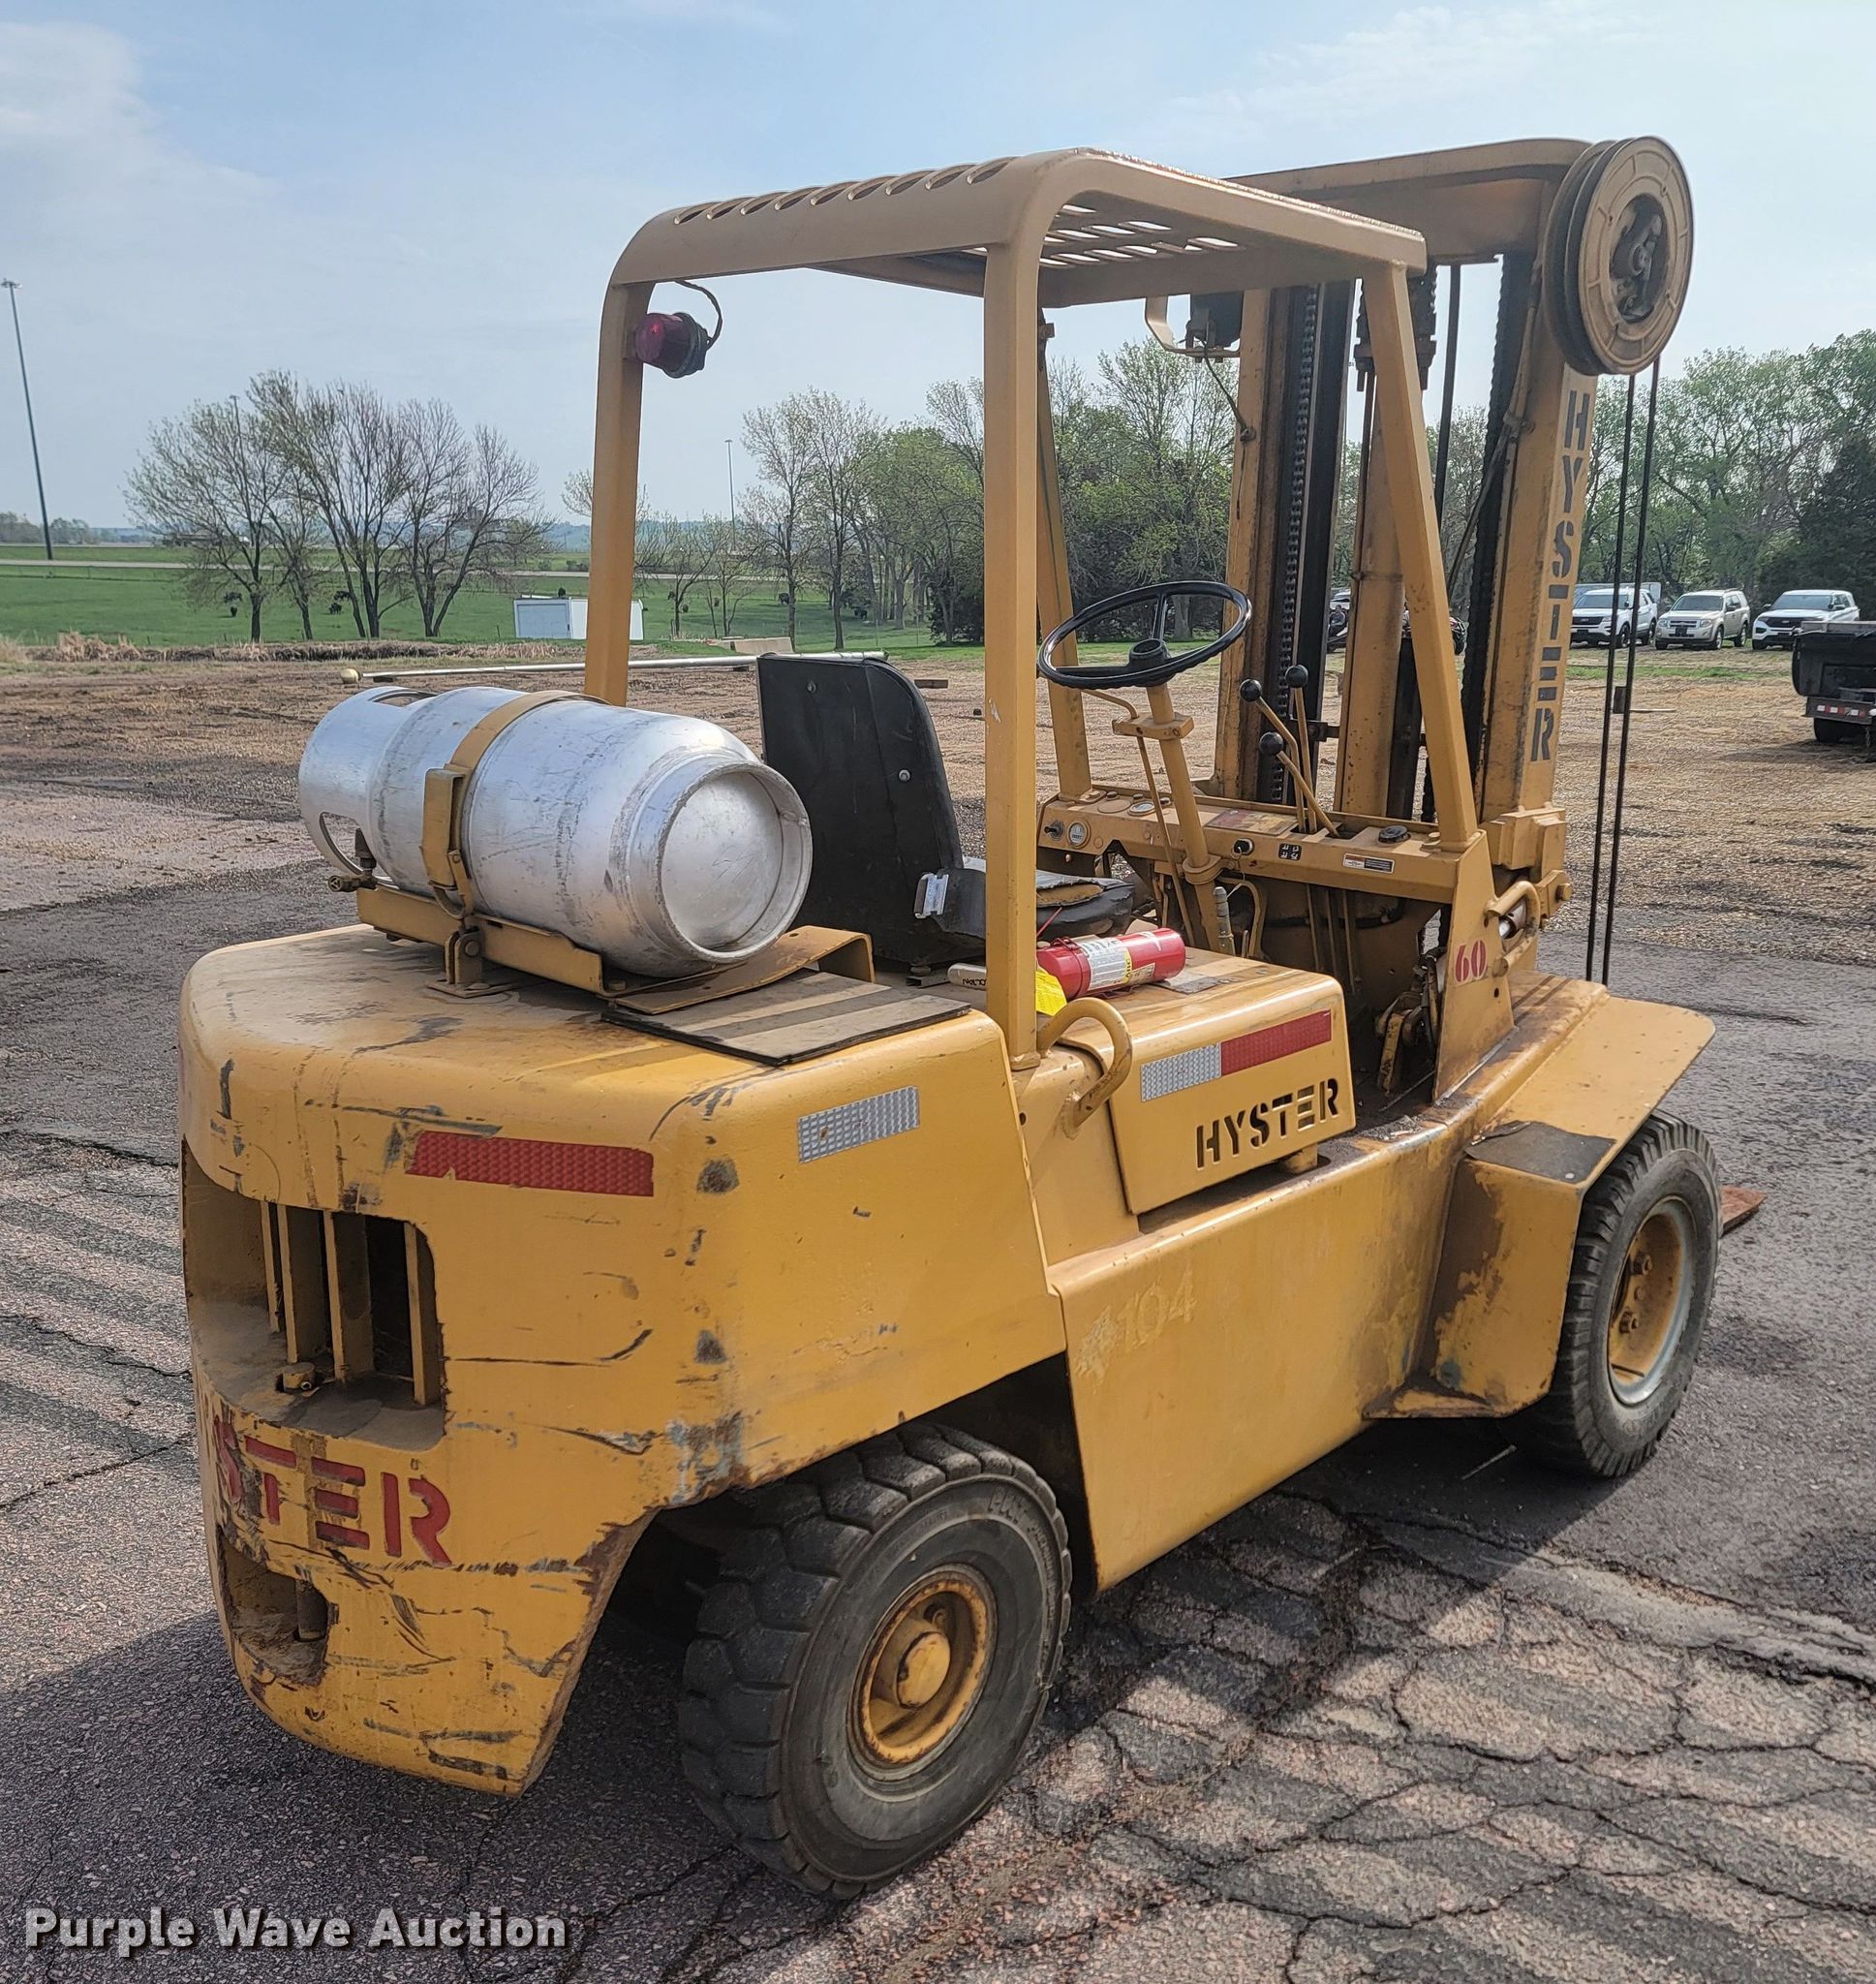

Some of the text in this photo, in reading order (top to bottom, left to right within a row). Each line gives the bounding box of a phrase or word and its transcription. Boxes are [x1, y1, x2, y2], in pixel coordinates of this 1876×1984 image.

[1530, 390, 1591, 761] HYSTER
[1455, 939, 1487, 982] 60
[1196, 1078, 1339, 1170] HYSTER
